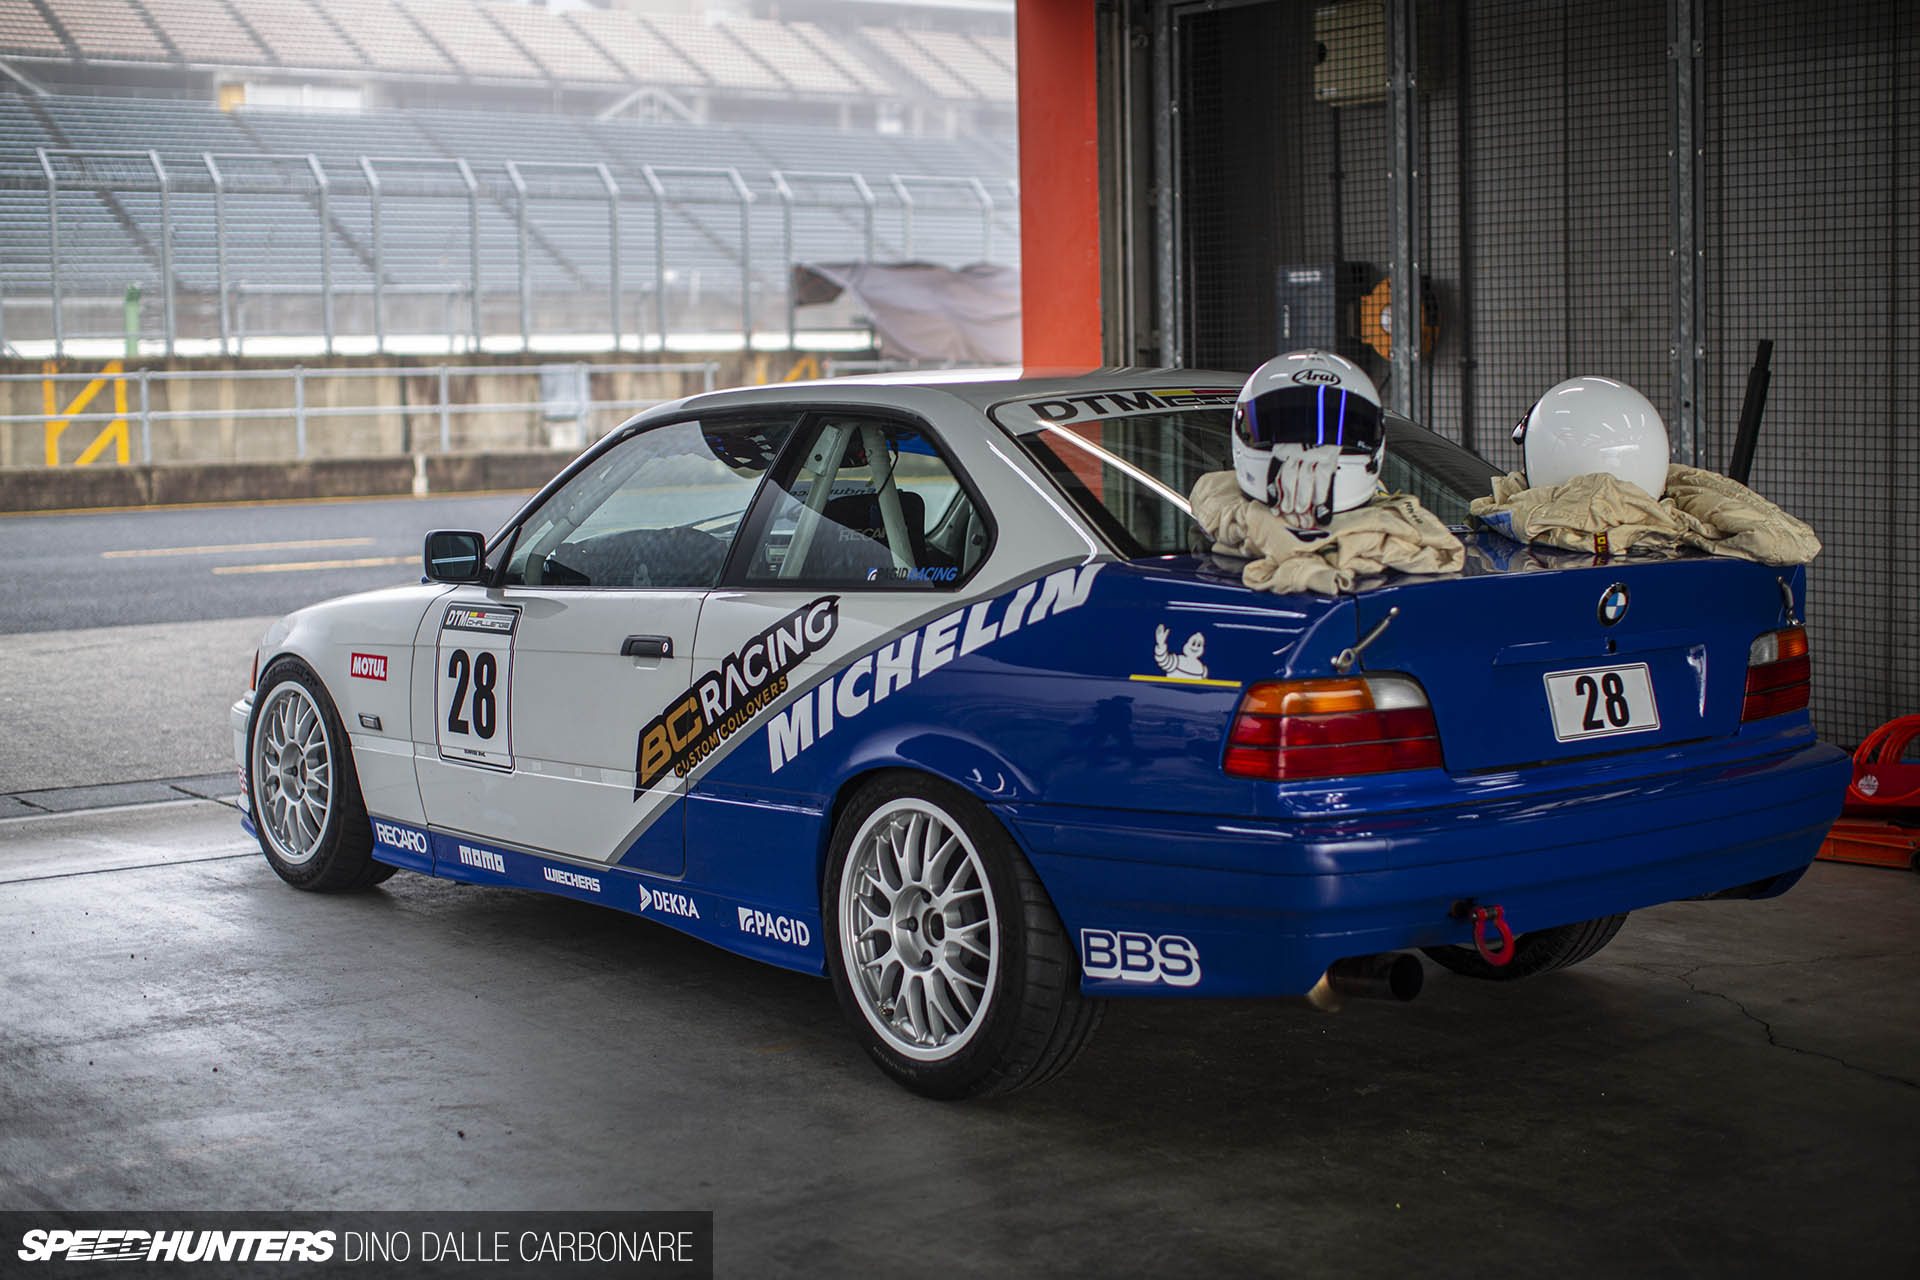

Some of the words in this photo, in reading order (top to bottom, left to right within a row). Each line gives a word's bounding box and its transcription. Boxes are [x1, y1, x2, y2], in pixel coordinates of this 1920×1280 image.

[1296, 369, 1336, 382] Arai
[1028, 391, 1168, 422] DTM
[908, 567, 958, 581] RACING
[446, 610, 470, 626] DTM
[352, 655, 386, 678] MOTUL
[767, 563, 1106, 774] MICHELIN
[448, 649, 496, 740] 28
[641, 696, 703, 785] BC
[699, 601, 831, 725] RACING
[1575, 672, 1630, 731] 28
[675, 731, 721, 777] CUSTOM
[720, 676, 787, 738] COILOVERS
[376, 823, 427, 854] RECARO
[544, 867, 601, 893] WIECHERS
[653, 889, 700, 920] DEKRA
[756, 909, 810, 947] PAGID
[1081, 928, 1202, 987] BBS
